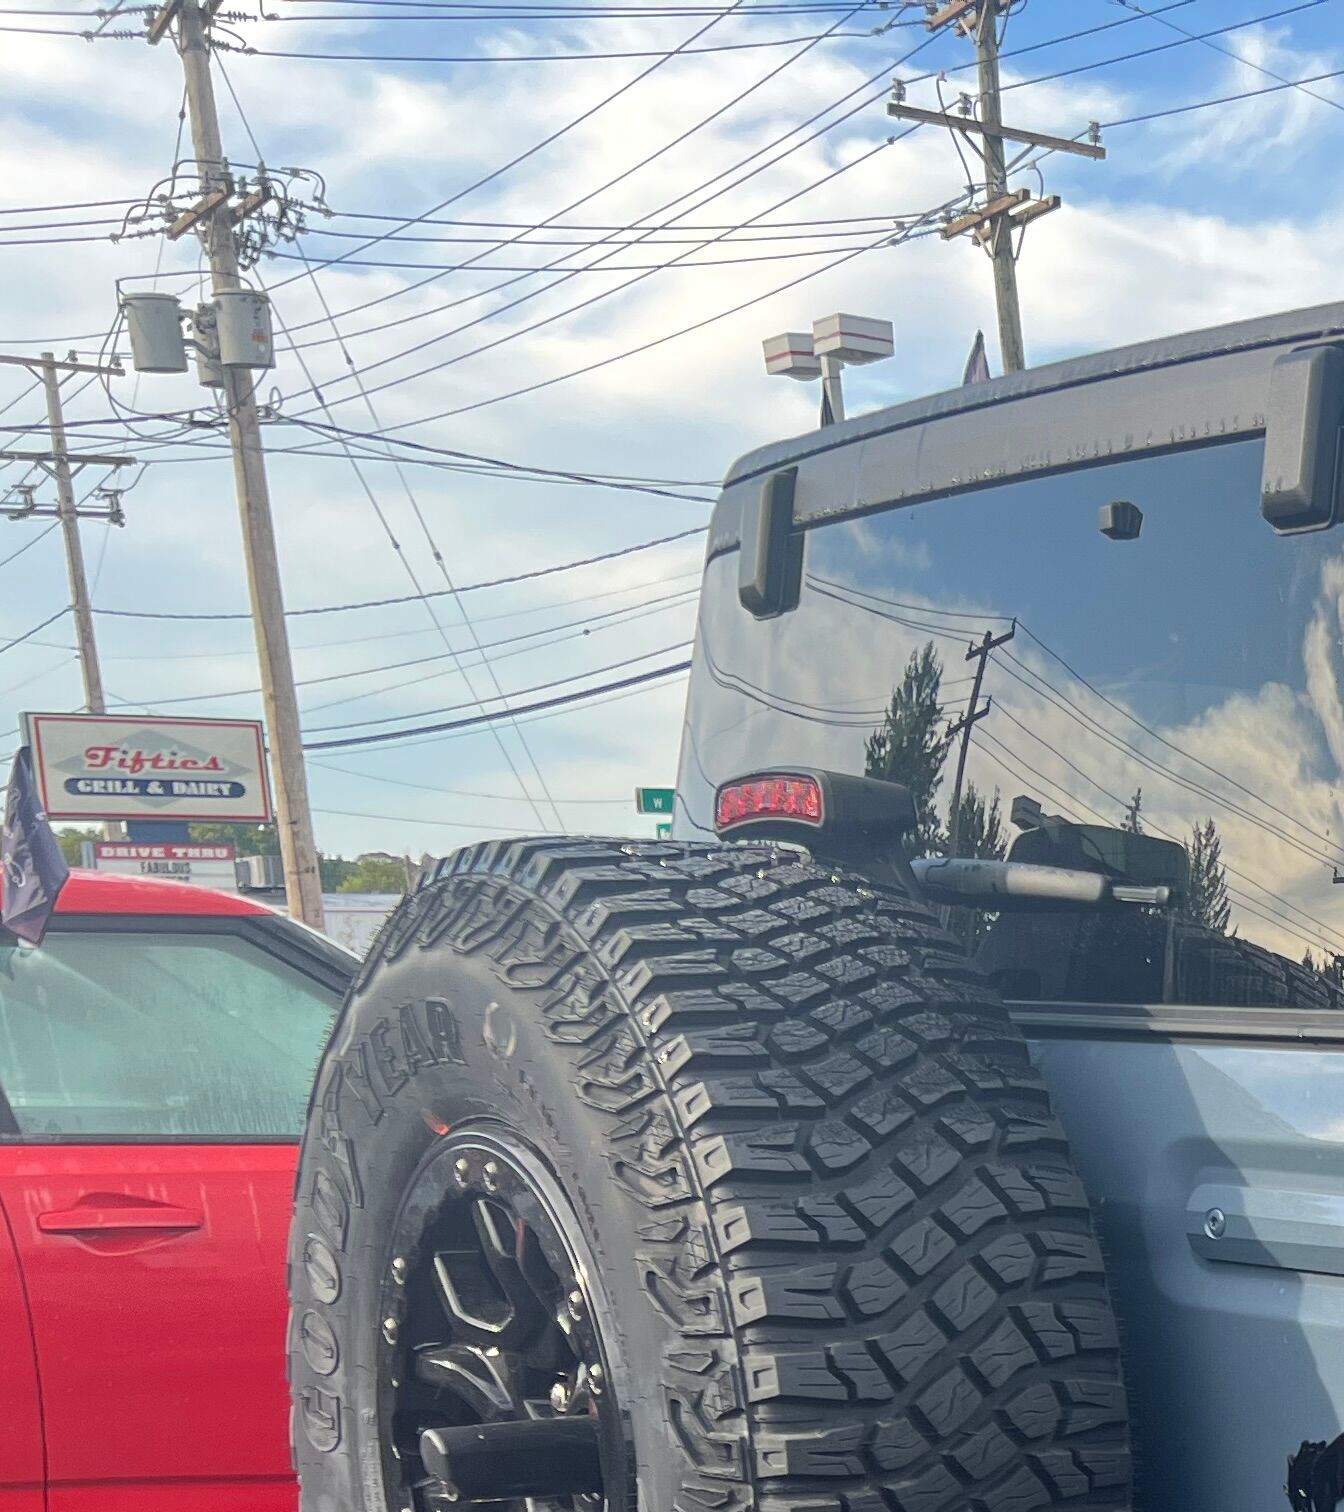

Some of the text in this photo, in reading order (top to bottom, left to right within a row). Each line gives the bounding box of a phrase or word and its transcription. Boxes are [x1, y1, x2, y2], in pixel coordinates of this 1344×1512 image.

[85, 747, 224, 773] Fifties
[77, 780, 232, 797] GRILL & DAIRY
[102, 847, 229, 858] DRIVE THRU
[141, 862, 190, 874] FABULOUS
